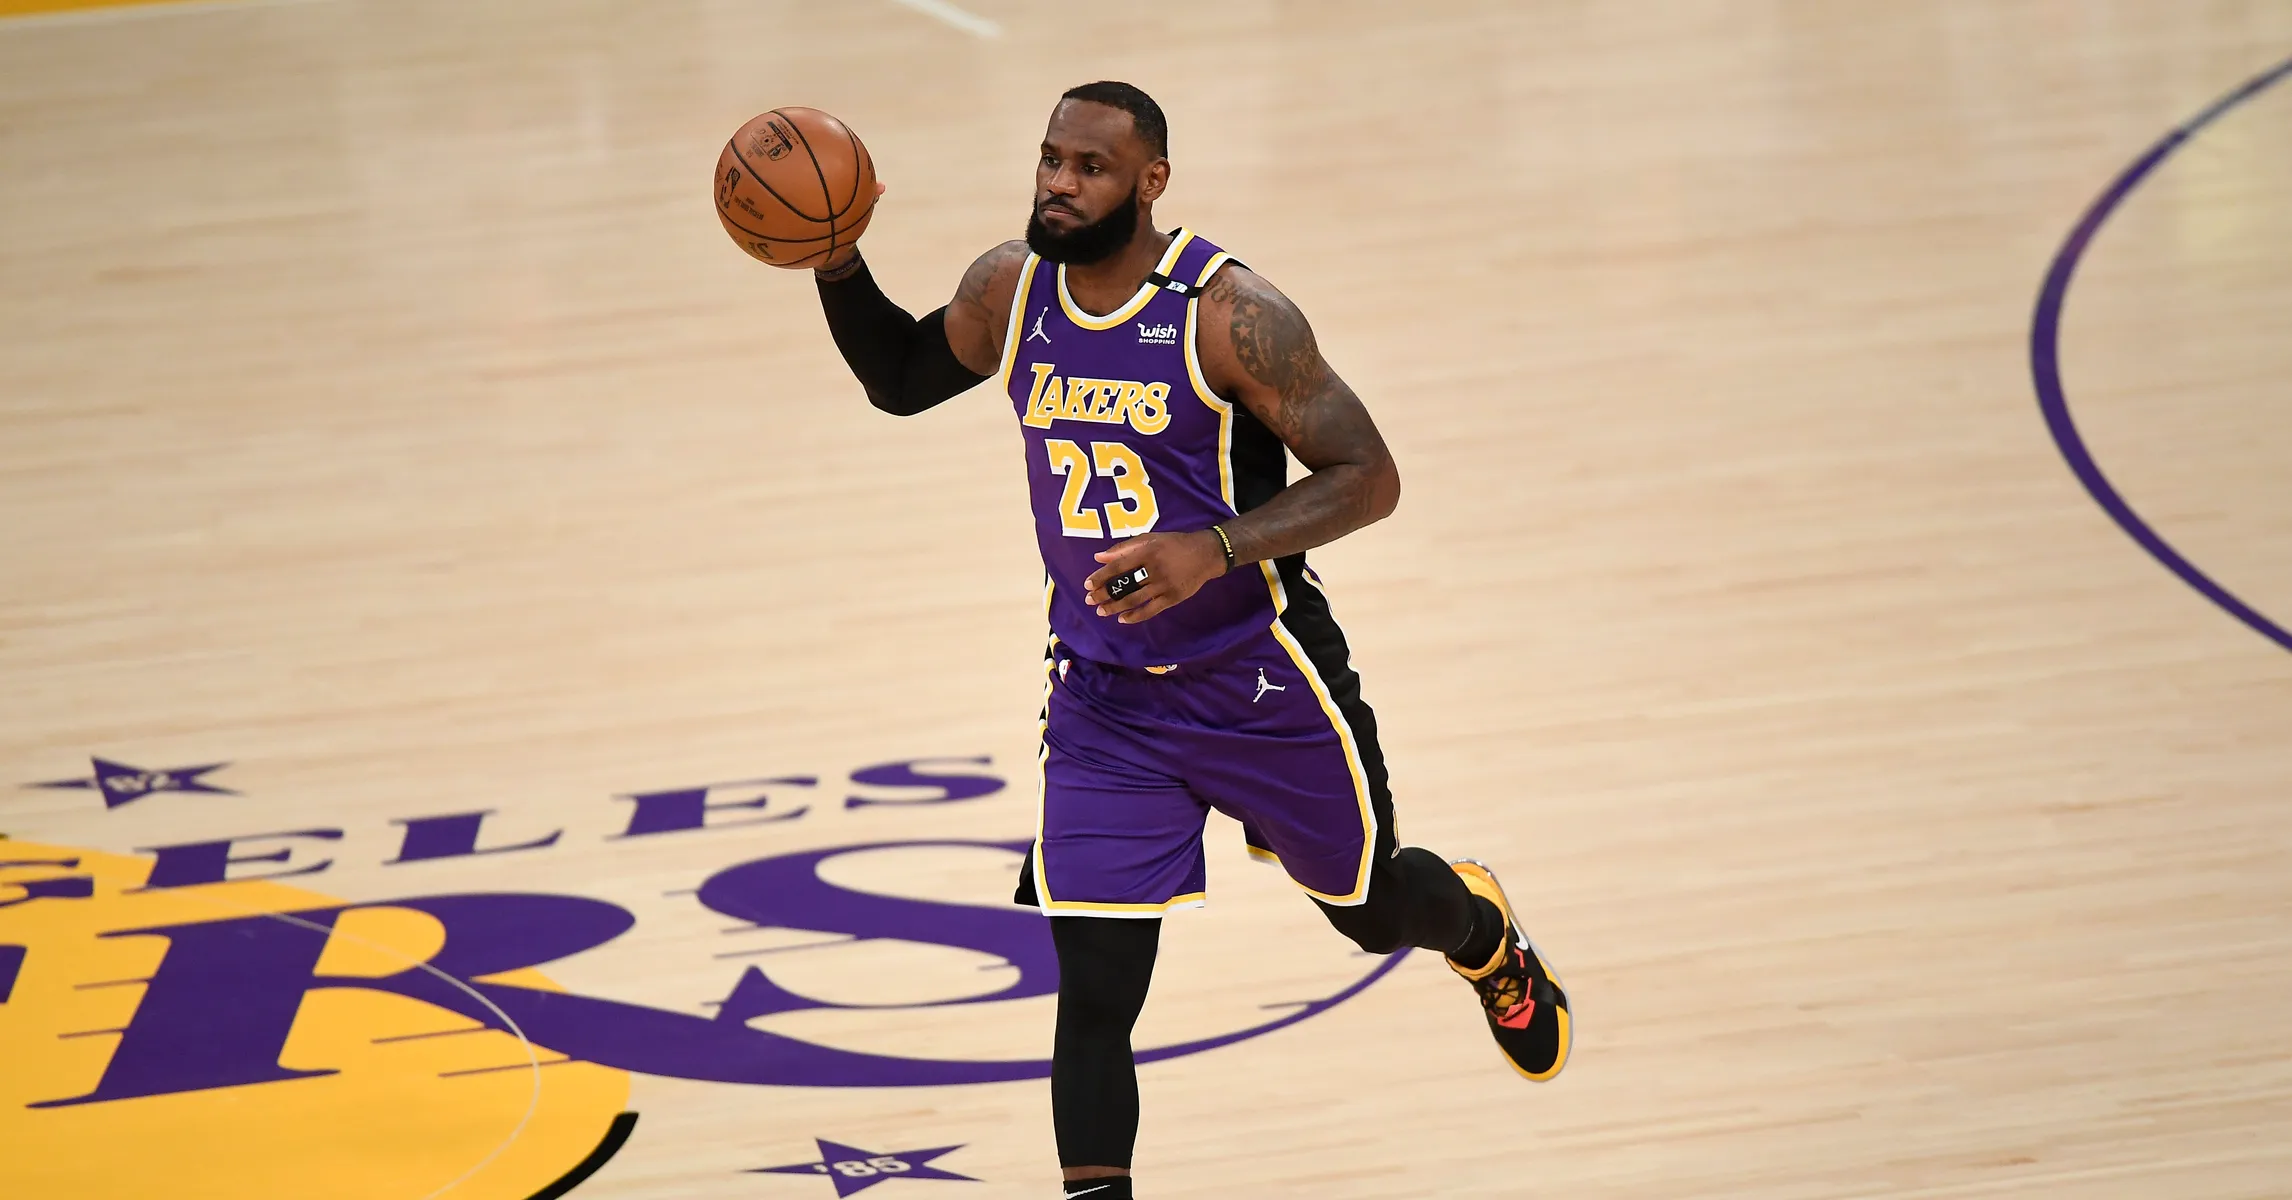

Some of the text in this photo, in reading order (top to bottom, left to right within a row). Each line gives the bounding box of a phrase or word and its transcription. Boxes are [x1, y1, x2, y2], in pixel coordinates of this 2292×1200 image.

[1022, 362, 1172, 436] LAKERS
[1044, 438, 1160, 539] 23
[1111, 576, 1130, 596] 24
[812, 1156, 912, 1178] '85
